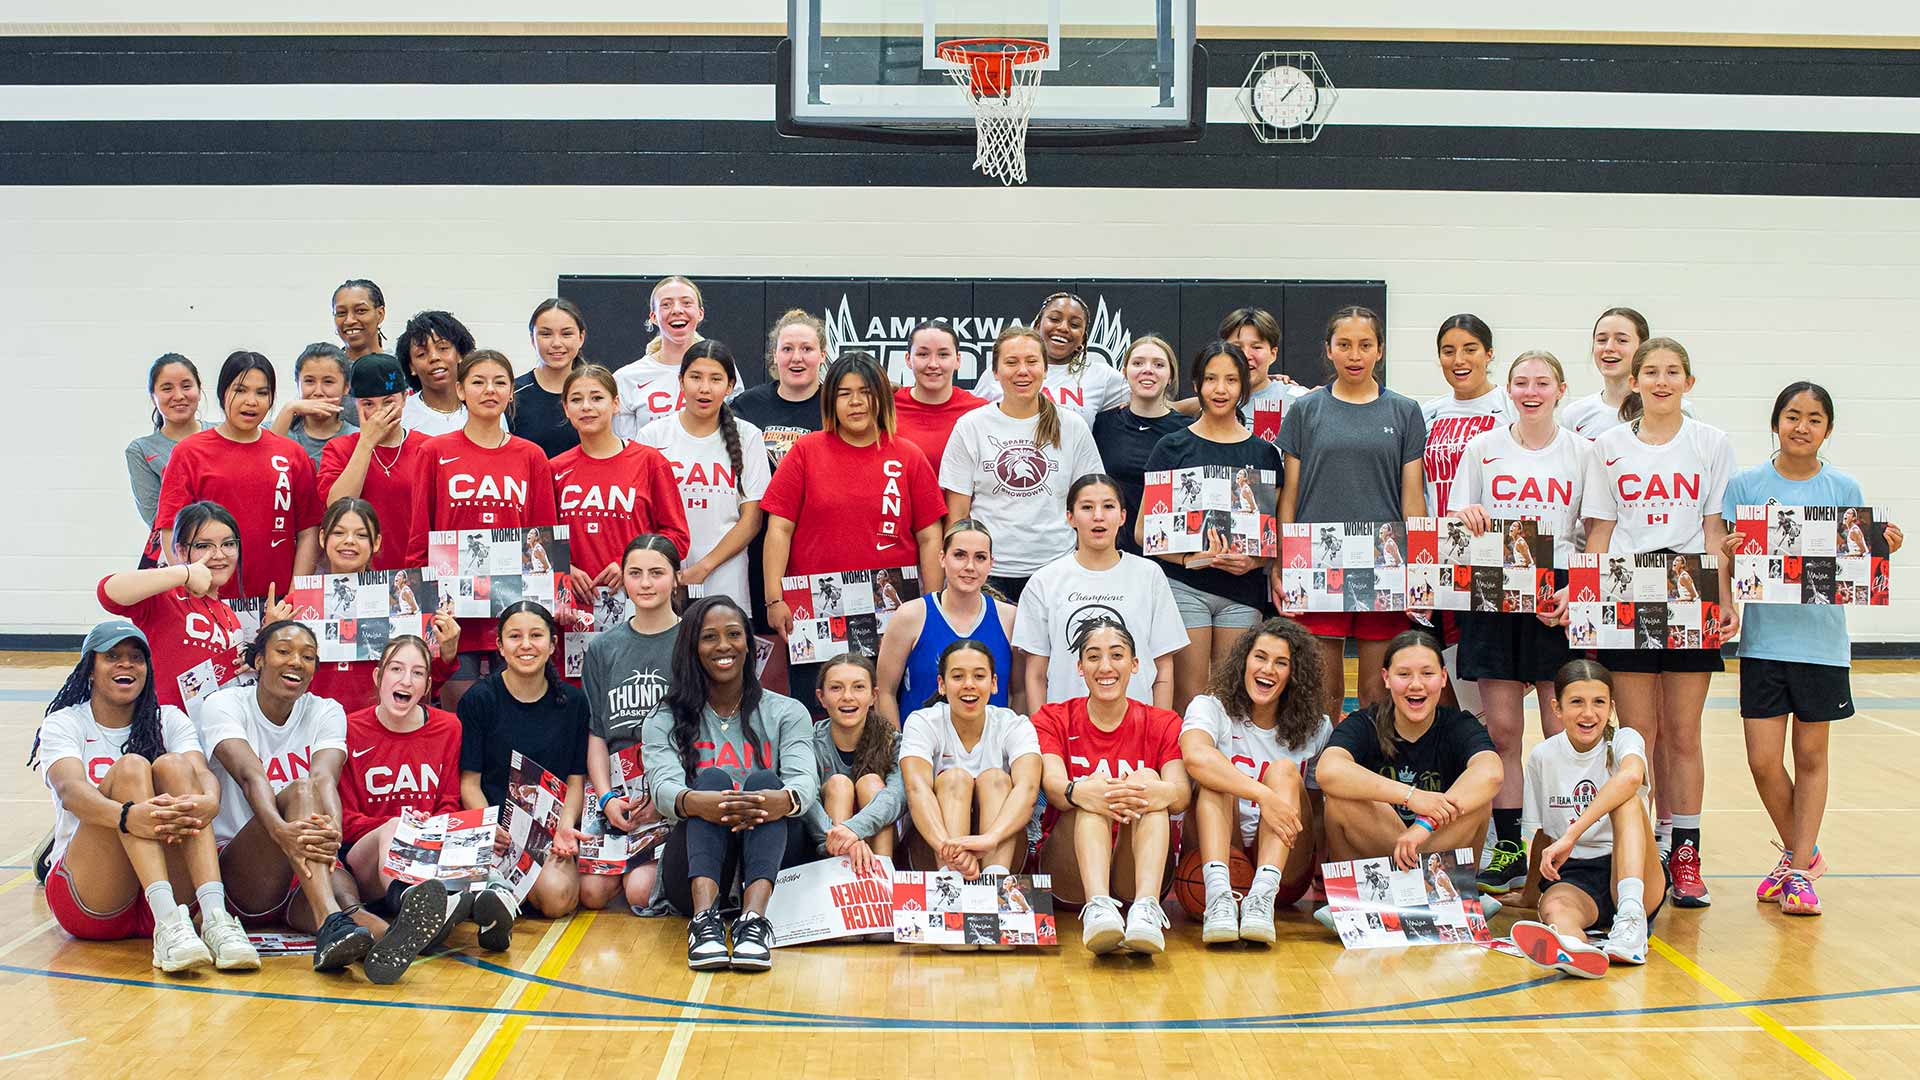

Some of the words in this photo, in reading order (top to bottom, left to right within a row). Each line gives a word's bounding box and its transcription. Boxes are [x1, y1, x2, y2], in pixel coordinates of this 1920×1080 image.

[1426, 415, 1496, 447] WATCH
[984, 462, 995, 470] 20
[1047, 462, 1058, 470] 23
[1202, 465, 1230, 479] WOMEN
[271, 455, 291, 512] CAN
[448, 474, 527, 506] CAN
[881, 460, 902, 517] CAN
[1001, 486, 1045, 498] SHOWDOWN
[1491, 475, 1572, 507] CAN
[1617, 473, 1700, 501] CAN
[560, 484, 636, 513] CAN
[560, 511, 632, 520] BASKETBALL
[1736, 504, 1766, 520] WATCH
[1803, 506, 1836, 521] WOMEN
[1344, 522, 1373, 536] WOMEN
[1408, 517, 1436, 531] WATCH
[491, 528, 520, 543] WOMEN
[1568, 553, 1598, 568] WATCH
[1634, 553, 1666, 568] WOMEN
[1701, 555, 1719, 569] WIN
[358, 570, 388, 585] WOMEN
[782, 576, 809, 591] WATCH
[841, 570, 870, 585] WOMEN
[901, 566, 918, 579] WIN
[1068, 591, 1125, 604] Champions
[365, 763, 443, 796] CAN
[1455, 848, 1475, 865] WIN
[1321, 861, 1353, 879] WATCH
[893, 871, 924, 884] WATCH
[1032, 874, 1052, 888] WIN
[829, 879, 894, 907] WOMEN
